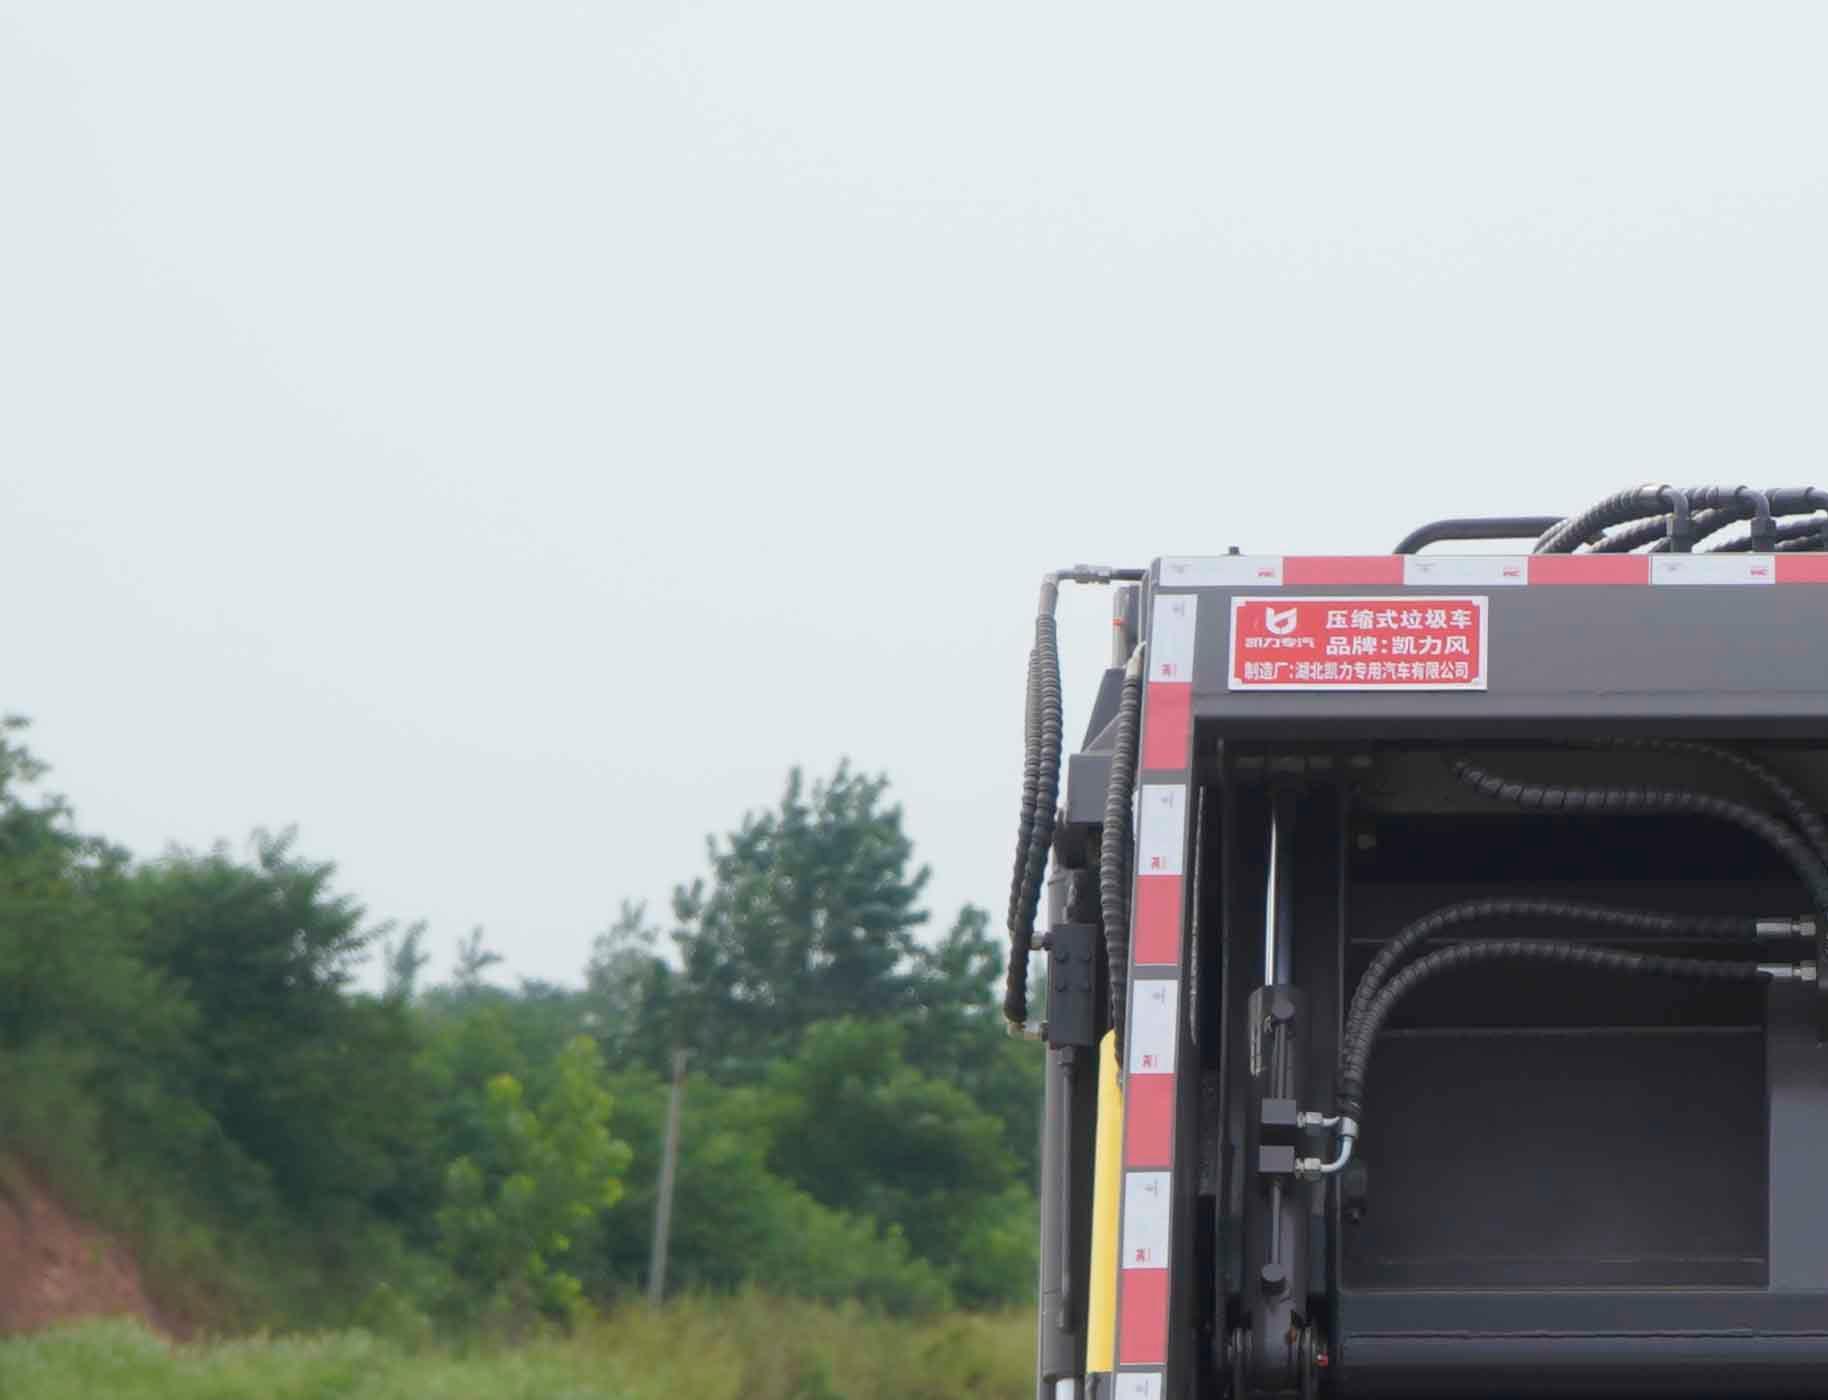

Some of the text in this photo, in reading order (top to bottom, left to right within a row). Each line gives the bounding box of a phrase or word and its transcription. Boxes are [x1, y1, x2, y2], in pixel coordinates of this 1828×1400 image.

[1325, 608, 1472, 630] 压缩式垃圾车
[1325, 635, 1470, 656] 品牌:凯力风
